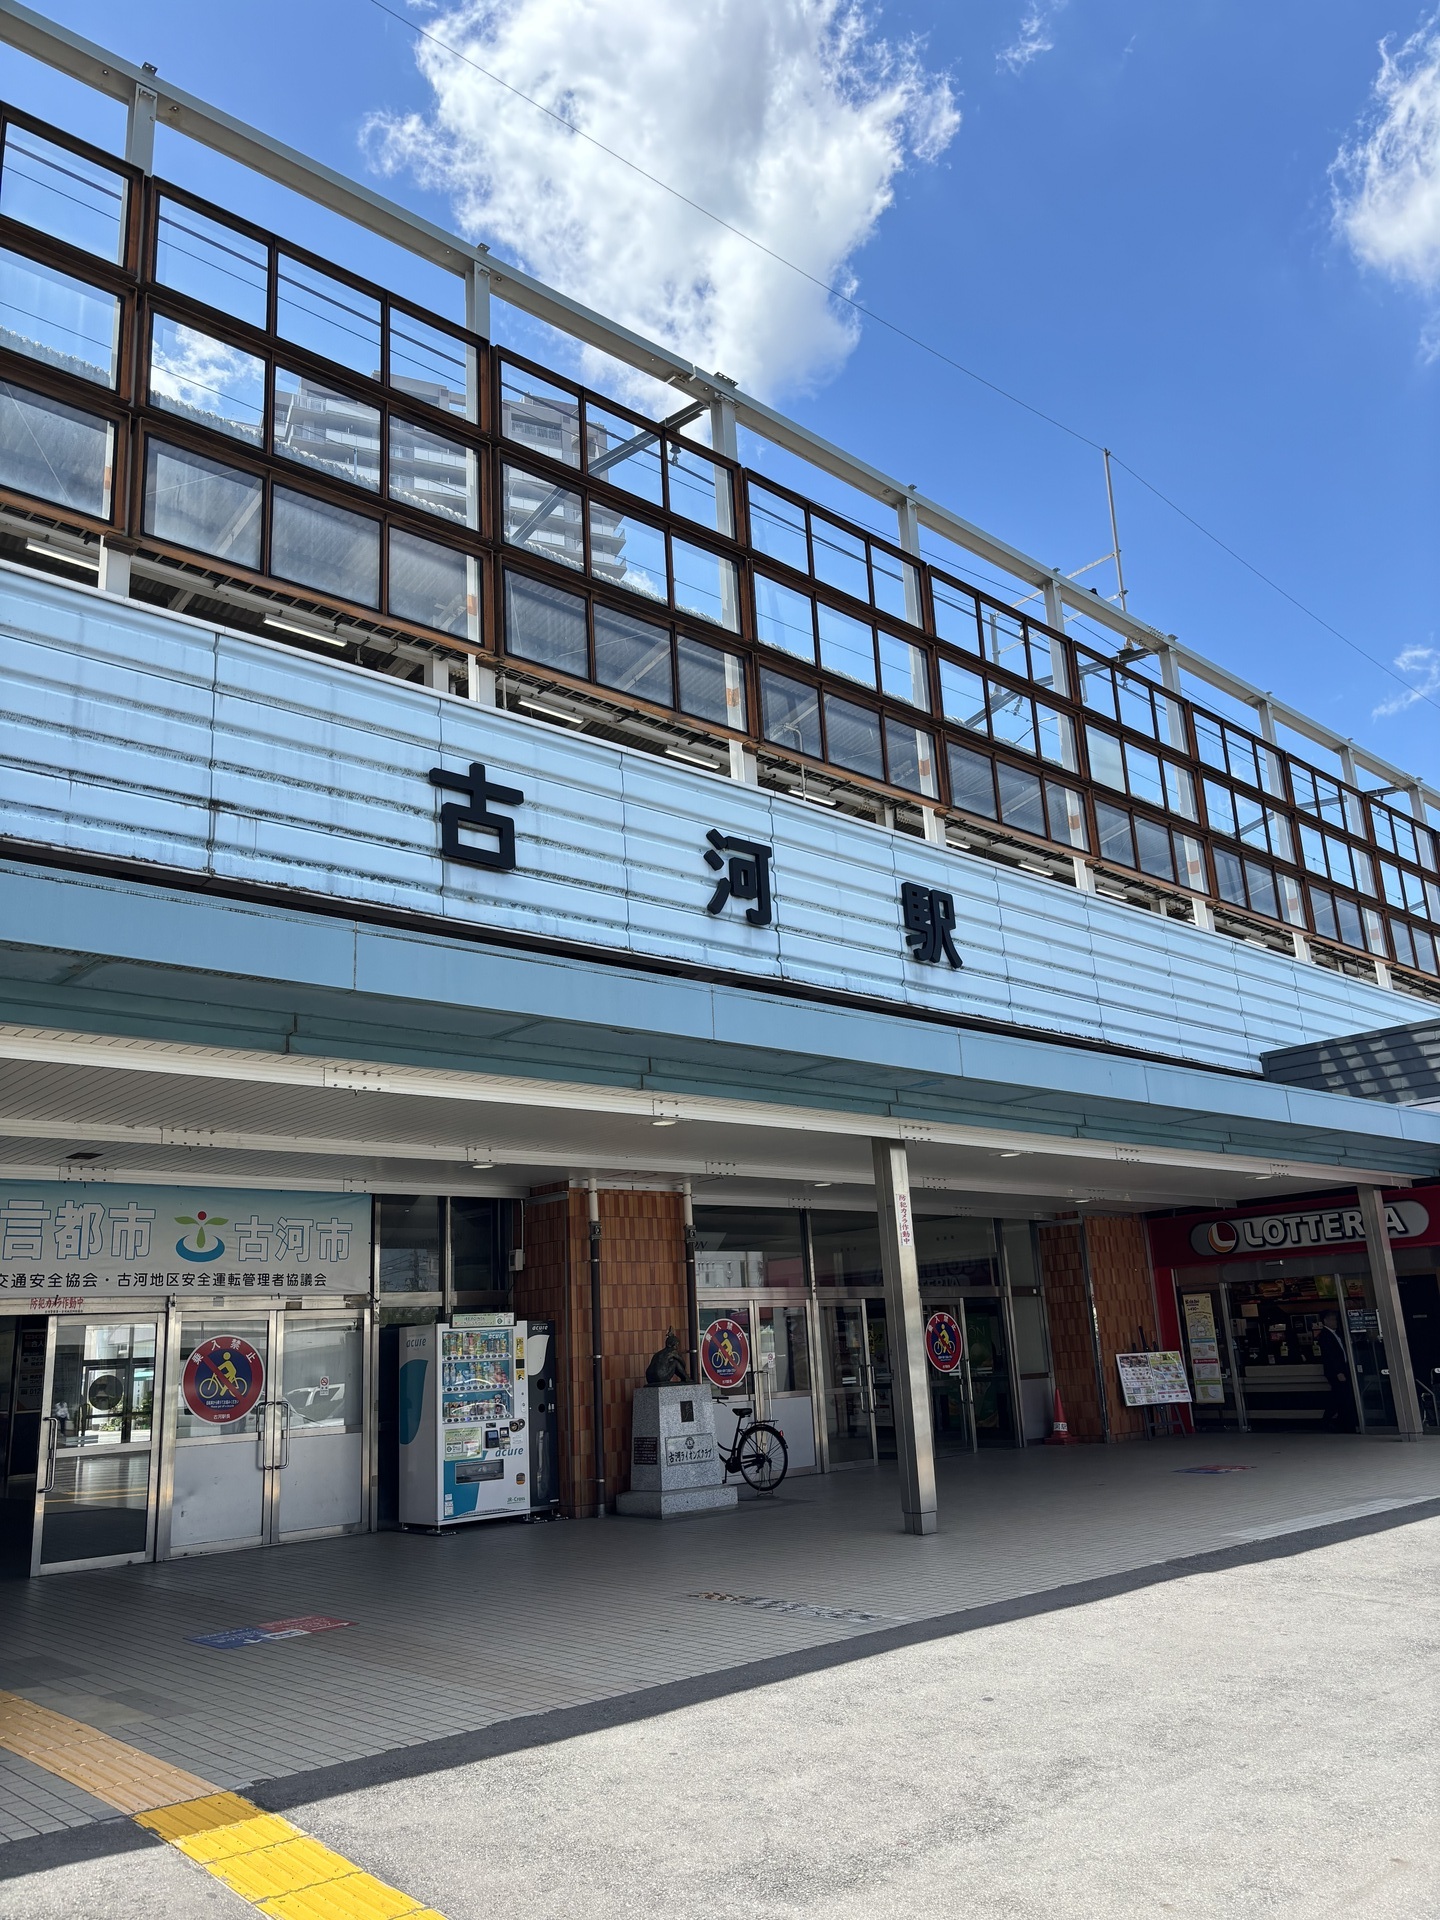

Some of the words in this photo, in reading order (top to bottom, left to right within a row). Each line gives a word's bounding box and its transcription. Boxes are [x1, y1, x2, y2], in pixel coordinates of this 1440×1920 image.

[429, 762, 963, 970] 古河駅
[0, 1199, 156, 1260] 言都市
[234, 1214, 353, 1262] 古河市
[899, 1194, 911, 1245] 防犯カメラ作動中
[1244, 1207, 1406, 1246] LOTTERA
[406, 1338, 427, 1348] acure
[495, 1447, 524, 1457] acure
